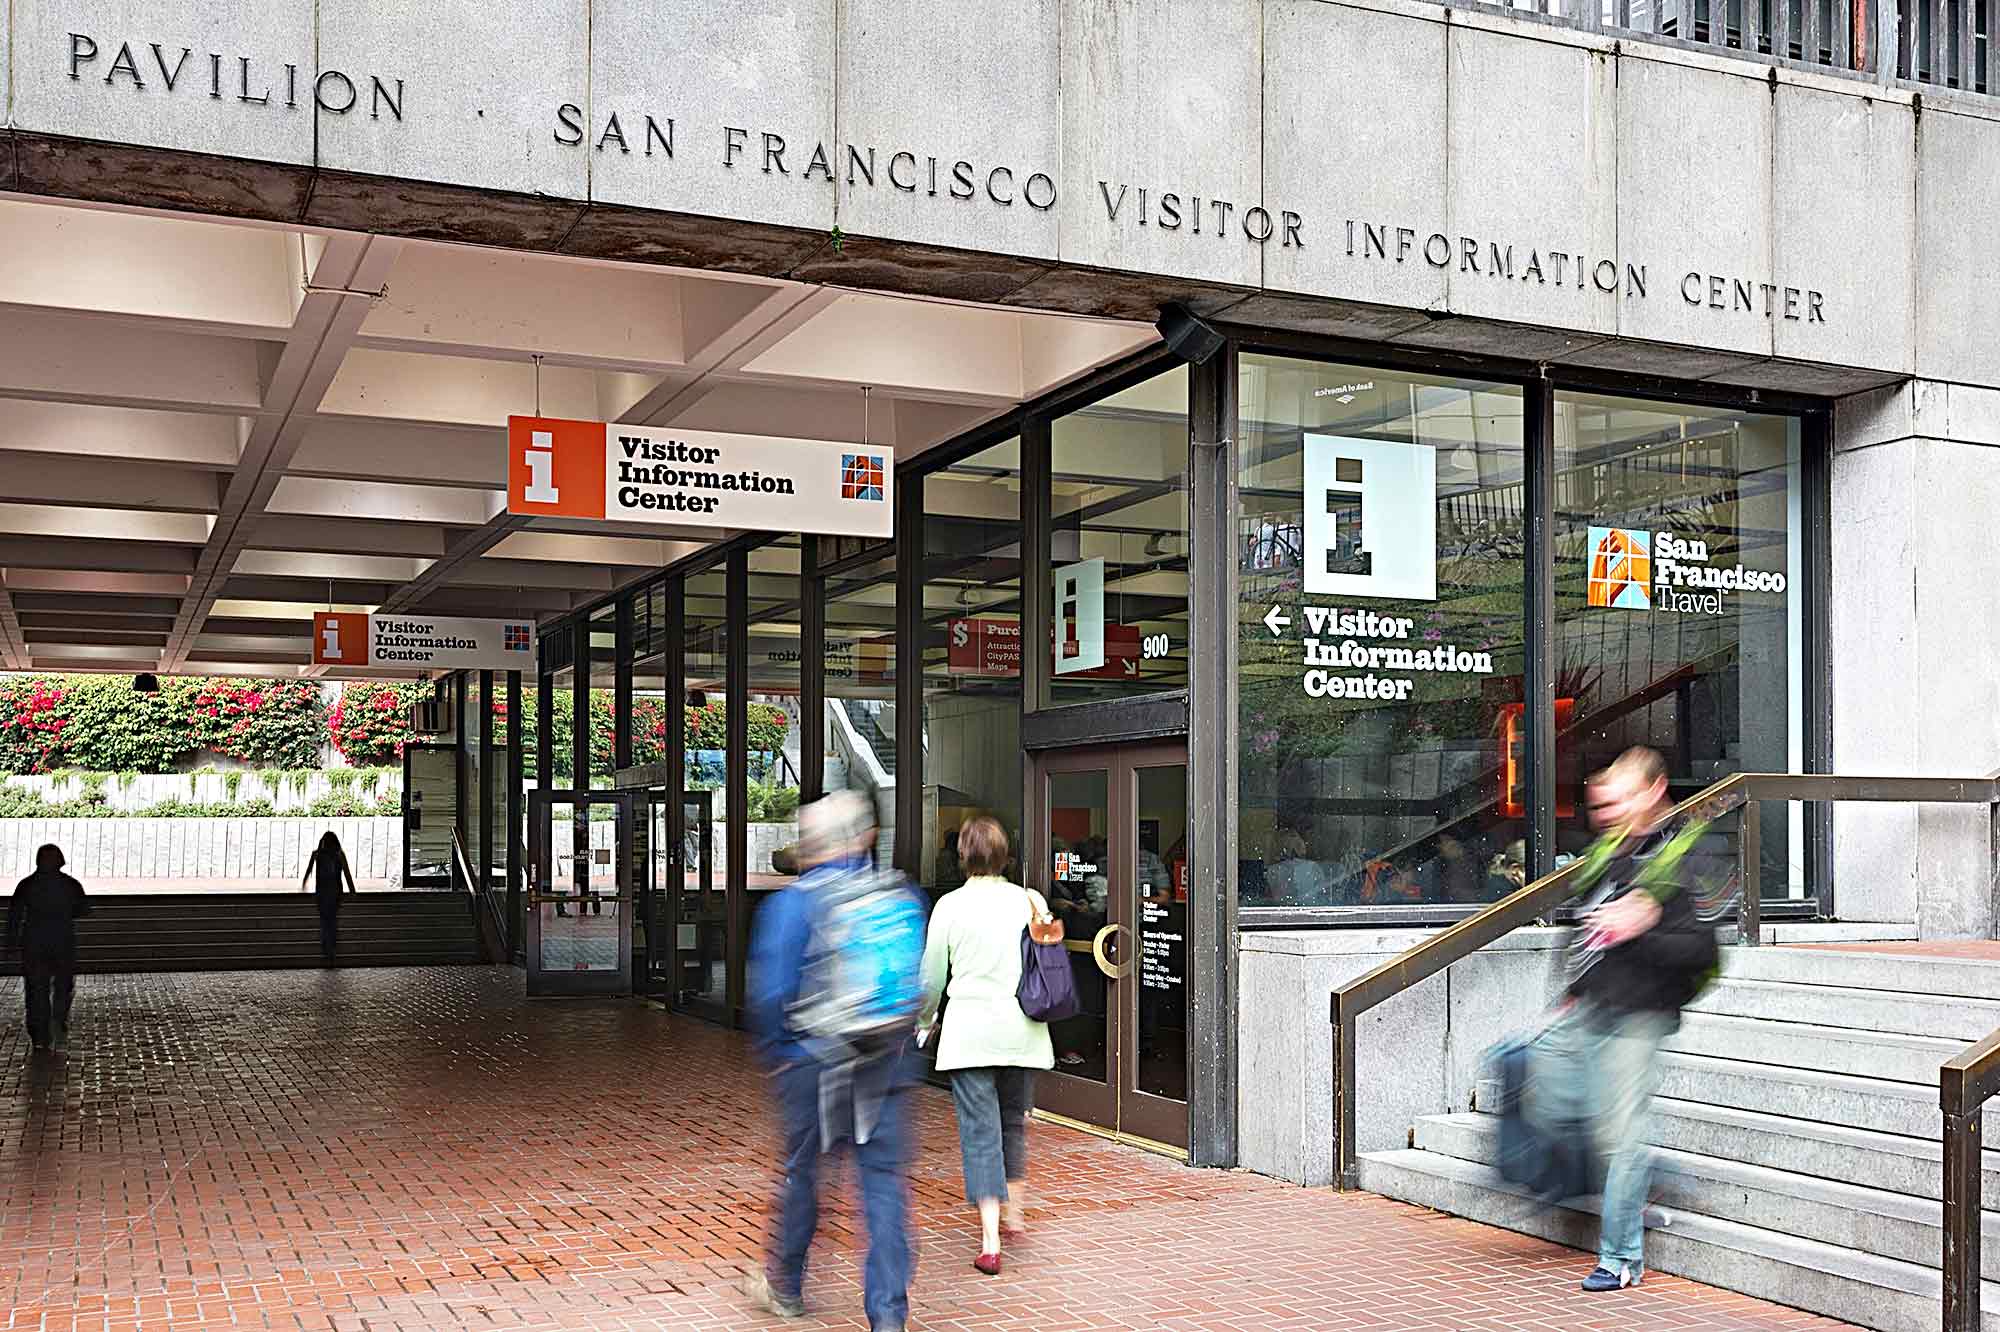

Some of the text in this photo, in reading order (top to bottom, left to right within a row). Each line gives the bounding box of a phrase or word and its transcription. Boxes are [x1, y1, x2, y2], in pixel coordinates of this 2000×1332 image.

[67, 32, 1825, 323] PAVILION SAN FRANCISCO VISITOR INFORMATION CENTER
[618, 436, 720, 464] Visitor
[525, 431, 559, 503] i
[618, 461, 795, 495] Information
[618, 486, 720, 513] Center
[1655, 531, 1708, 561] San
[1655, 558, 1786, 593] Francisco
[375, 620, 434, 635] Visitor
[987, 624, 1020, 636] Purc
[1303, 606, 1414, 639] Visitor
[322, 619, 343, 659] i
[375, 634, 478, 650] Information
[1143, 633, 1169, 659] 900
[375, 648, 434, 661] Center
[987, 662, 1008, 671] Maps
[1303, 637, 1494, 674] Information
[1303, 669, 1414, 700] Center
[1068, 853, 1080, 862] San
[1069, 862, 1097, 873] Francisco
